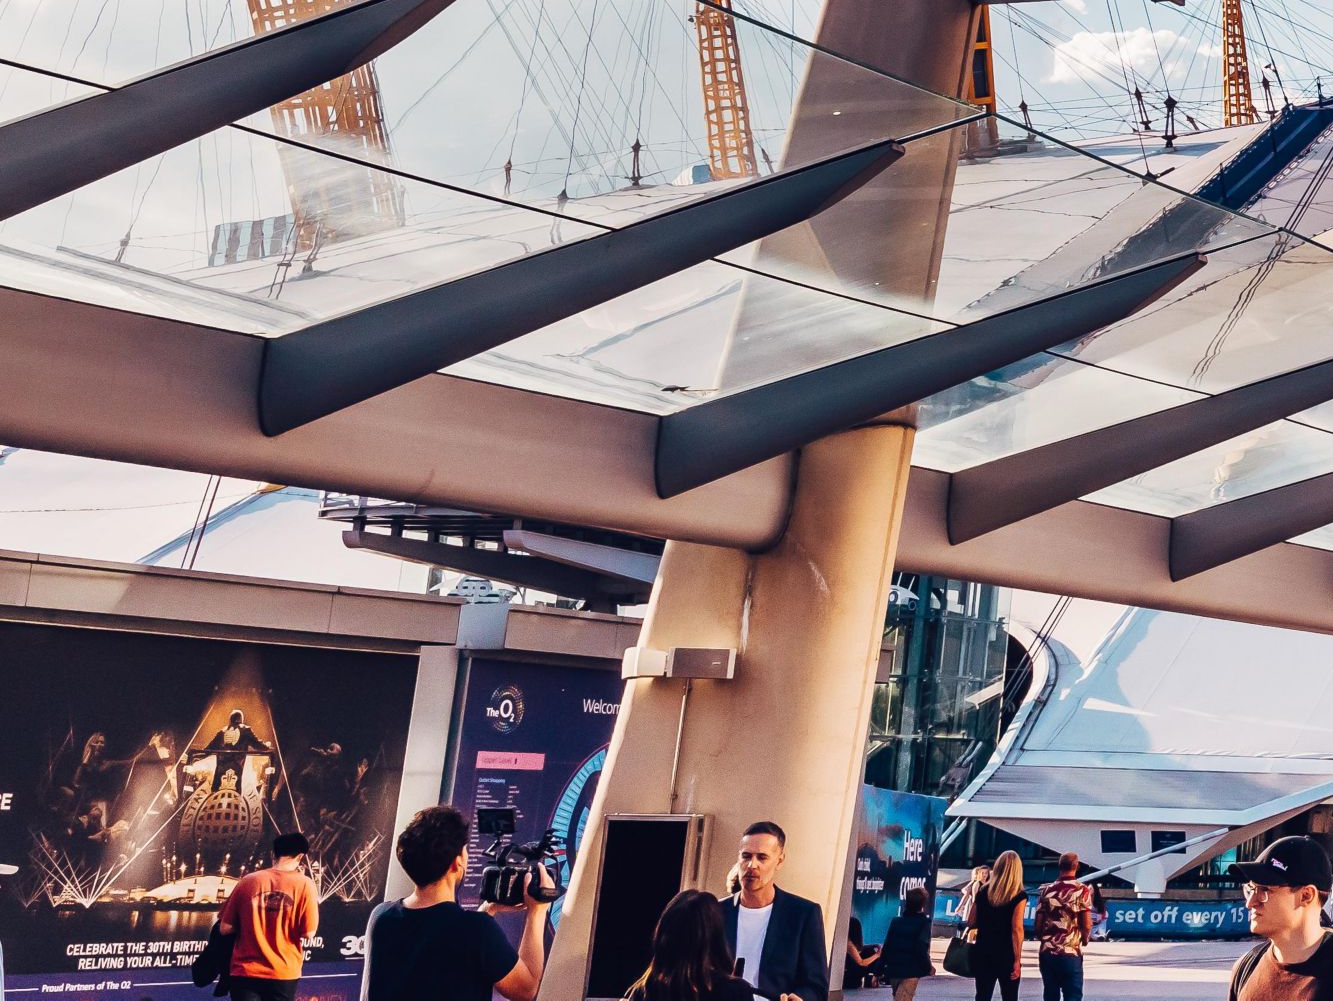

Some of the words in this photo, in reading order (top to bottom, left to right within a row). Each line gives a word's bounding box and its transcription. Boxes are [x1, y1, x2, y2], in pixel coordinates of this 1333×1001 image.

[486, 707, 499, 718] The
[583, 698, 621, 715] Welcom
[0, 793, 13, 810] E
[903, 830, 923, 862] Here
[1115, 907, 1145, 923] set
[1150, 906, 1179, 924] off
[1182, 911, 1226, 928] every
[1230, 907, 1244, 923] 15
[66, 943, 124, 956] CELEBRATE
[127, 942, 147, 954] THE
[147, 941, 171, 953] 30TH
[173, 941, 208, 952] BIRTHD
[78, 957, 124, 970] RELIVING
[127, 956, 151, 968] YOUR
[42, 983, 64, 993] Proud
[65, 982, 96, 992] Partners
[96, 982, 105, 990] of
[106, 981, 119, 990] The
